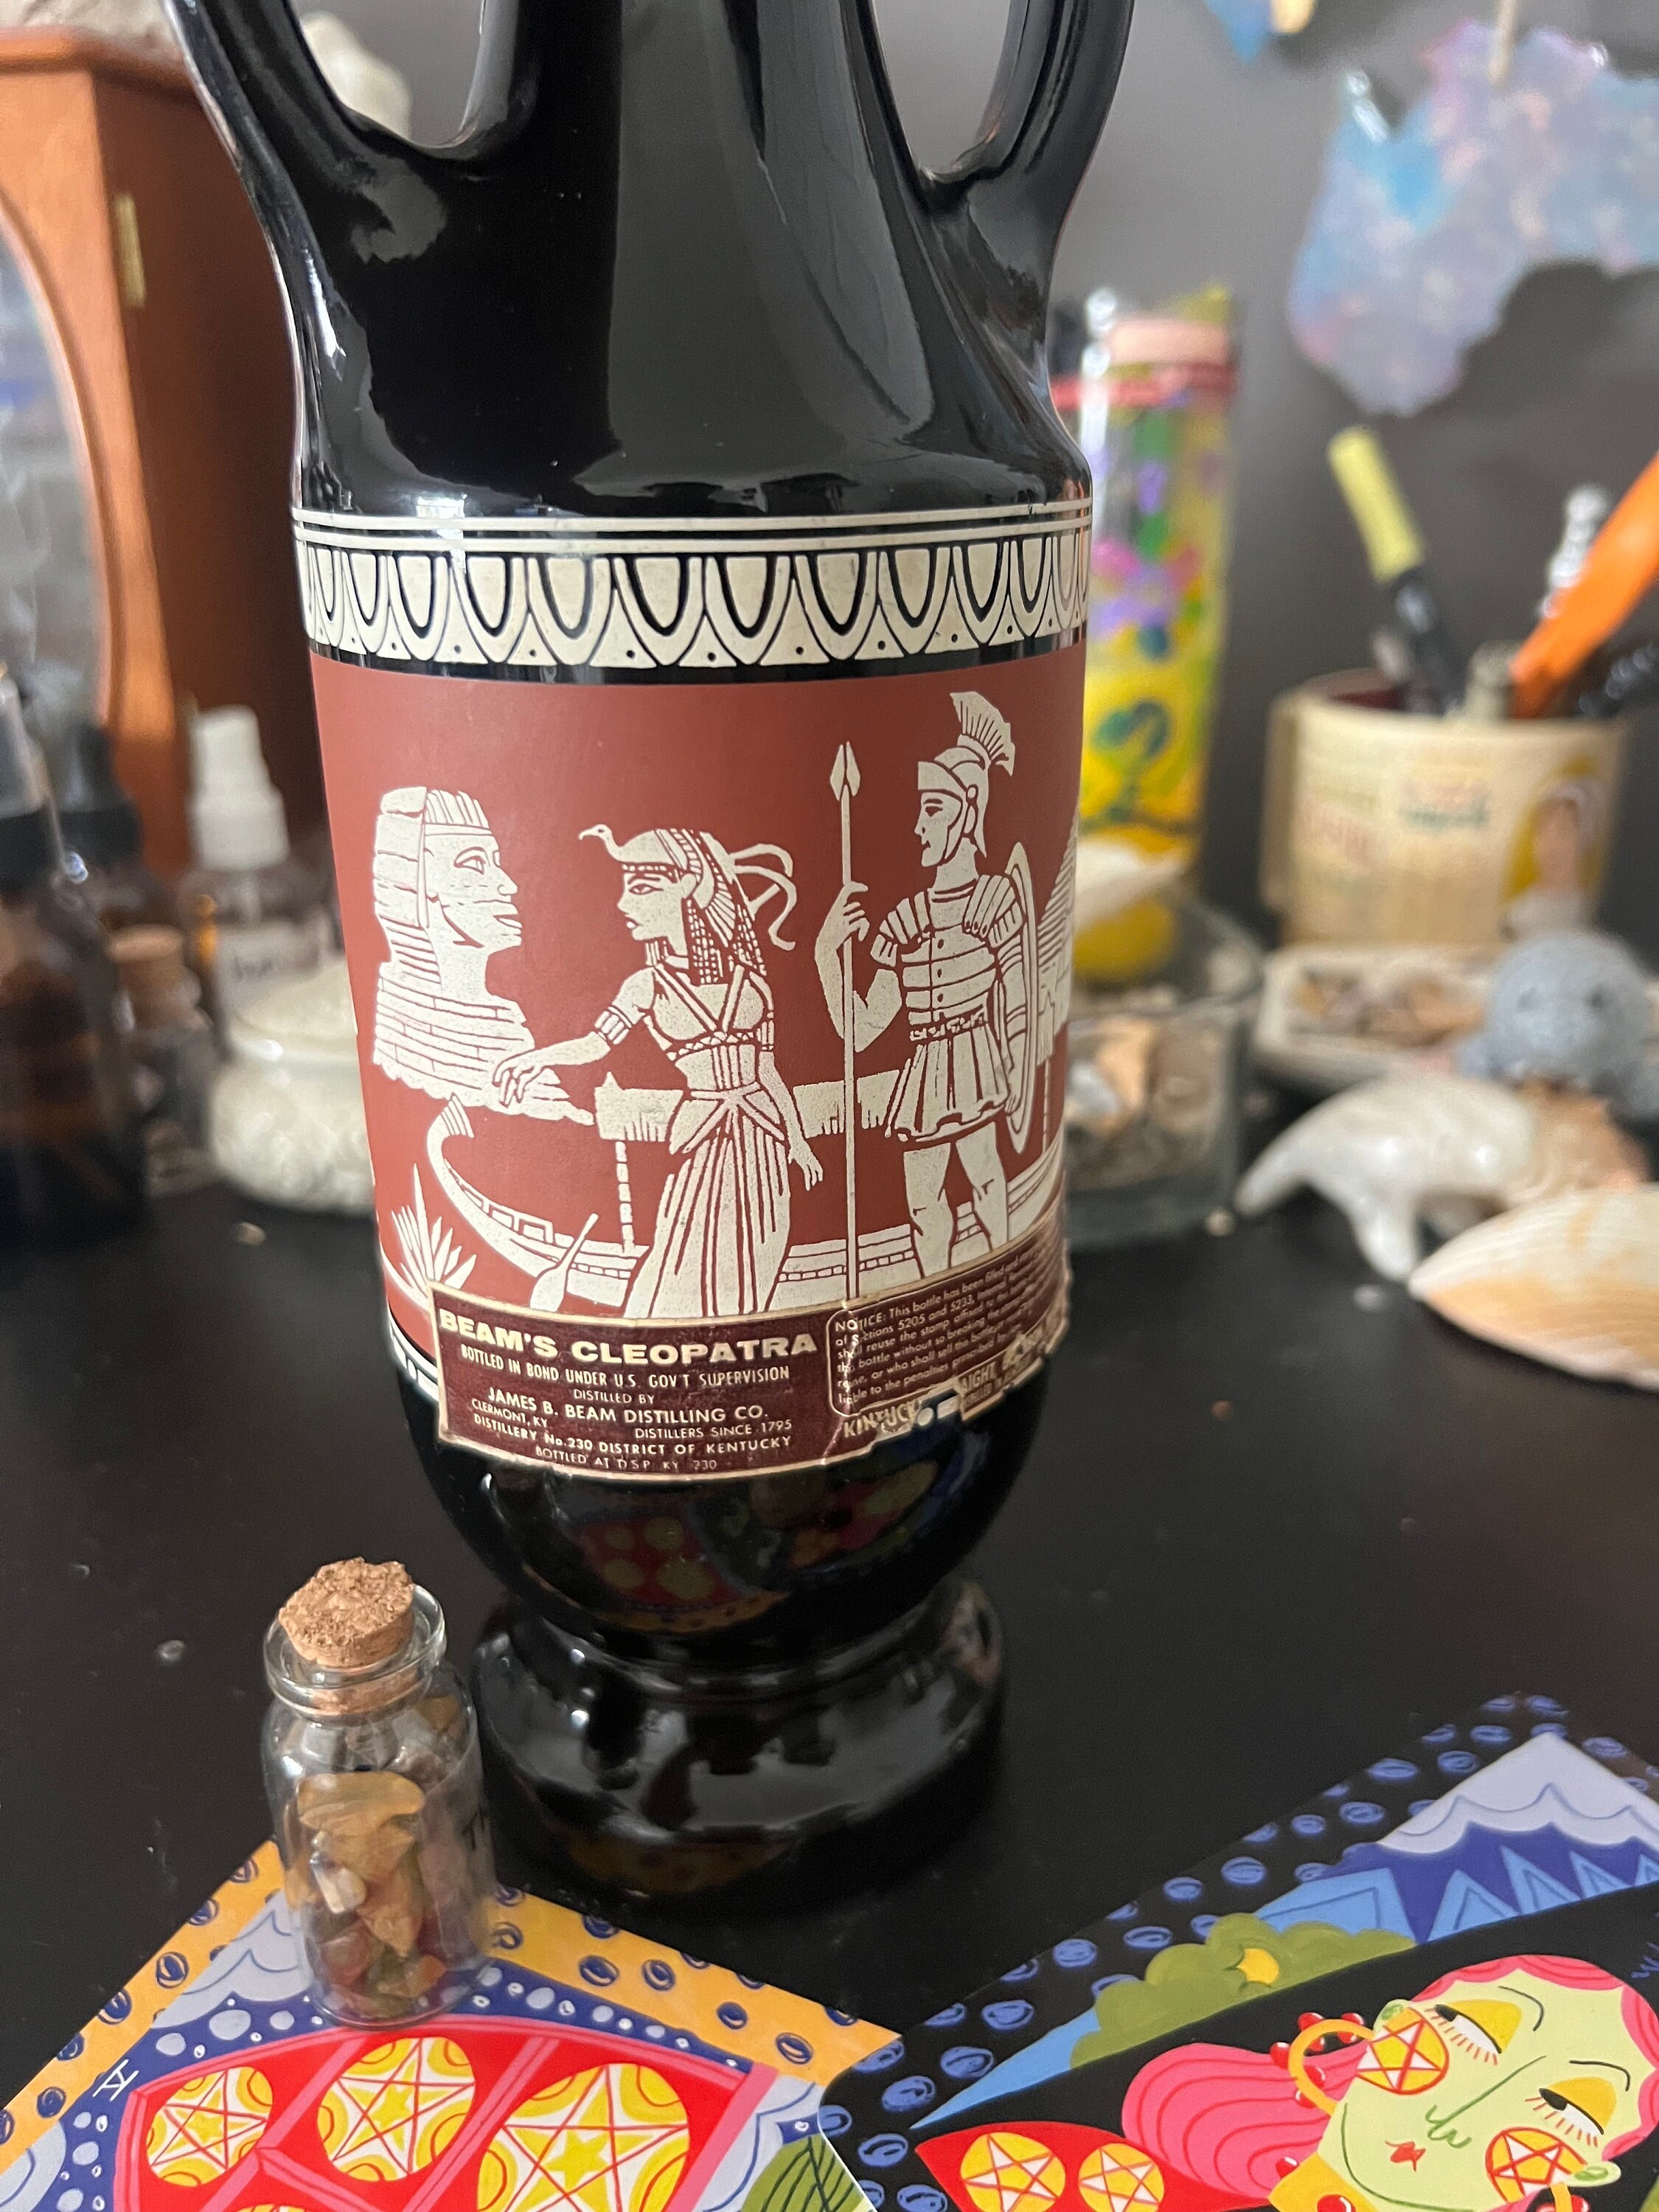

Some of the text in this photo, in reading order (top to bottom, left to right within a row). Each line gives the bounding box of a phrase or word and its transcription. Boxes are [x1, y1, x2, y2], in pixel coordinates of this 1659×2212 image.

[889, 1306, 911, 1318] This
[913, 1295, 942, 1312] bottle
[944, 1287, 960, 1300] has
[961, 1279, 984, 1293] been
[439, 1307, 818, 1365] BEAM'S CLEOPATRA
[835, 1335, 847, 1346] of
[852, 1325, 894, 1344] Sctions
[897, 1313, 925, 1330] 5205
[929, 1304, 947, 1321] and
[858, 1352, 890, 1368] bottle
[893, 1340, 933, 1357] without
[935, 1335, 945, 1346] so
[947, 1317, 985, 1340] breaking
[866, 1338, 896, 1352] reuse
[900, 1330, 917, 1342] the
[921, 1319, 950, 1336] stamp
[460, 1343, 504, 1370] BOTTLED
[508, 1357, 521, 1375] IN
[526, 1362, 560, 1381] BOND
[565, 1368, 608, 1386] UNDER
[699, 1365, 790, 1387] SUPERVISION
[870, 1385, 882, 1395] to
[885, 1380, 901, 1391] the
[903, 1363, 949, 1387] penalties
[872, 1370, 883, 1380] or
[886, 1362, 908, 1374] who
[911, 1349, 936, 1367] shall
[938, 1343, 953, 1358] sell
[471, 1397, 531, 1426] CLERMONT,
[487, 1386, 768, 1424] JAMES B. BEAM DISTILLING CO.
[573, 1388, 655, 1405] DISTILLED BY
[473, 1413, 538, 1441] DISTILLERY
[599, 1441, 665, 1455] DISTRICT
[674, 1444, 695, 1455] OF
[706, 1435, 791, 1454] KENTUCKY
[635, 1419, 793, 1439] DISTILLERS SINCE 1795
[535, 1444, 588, 1464] BOTTLED
[594, 1456, 610, 1470] AT
[663, 1460, 679, 1470] KY
